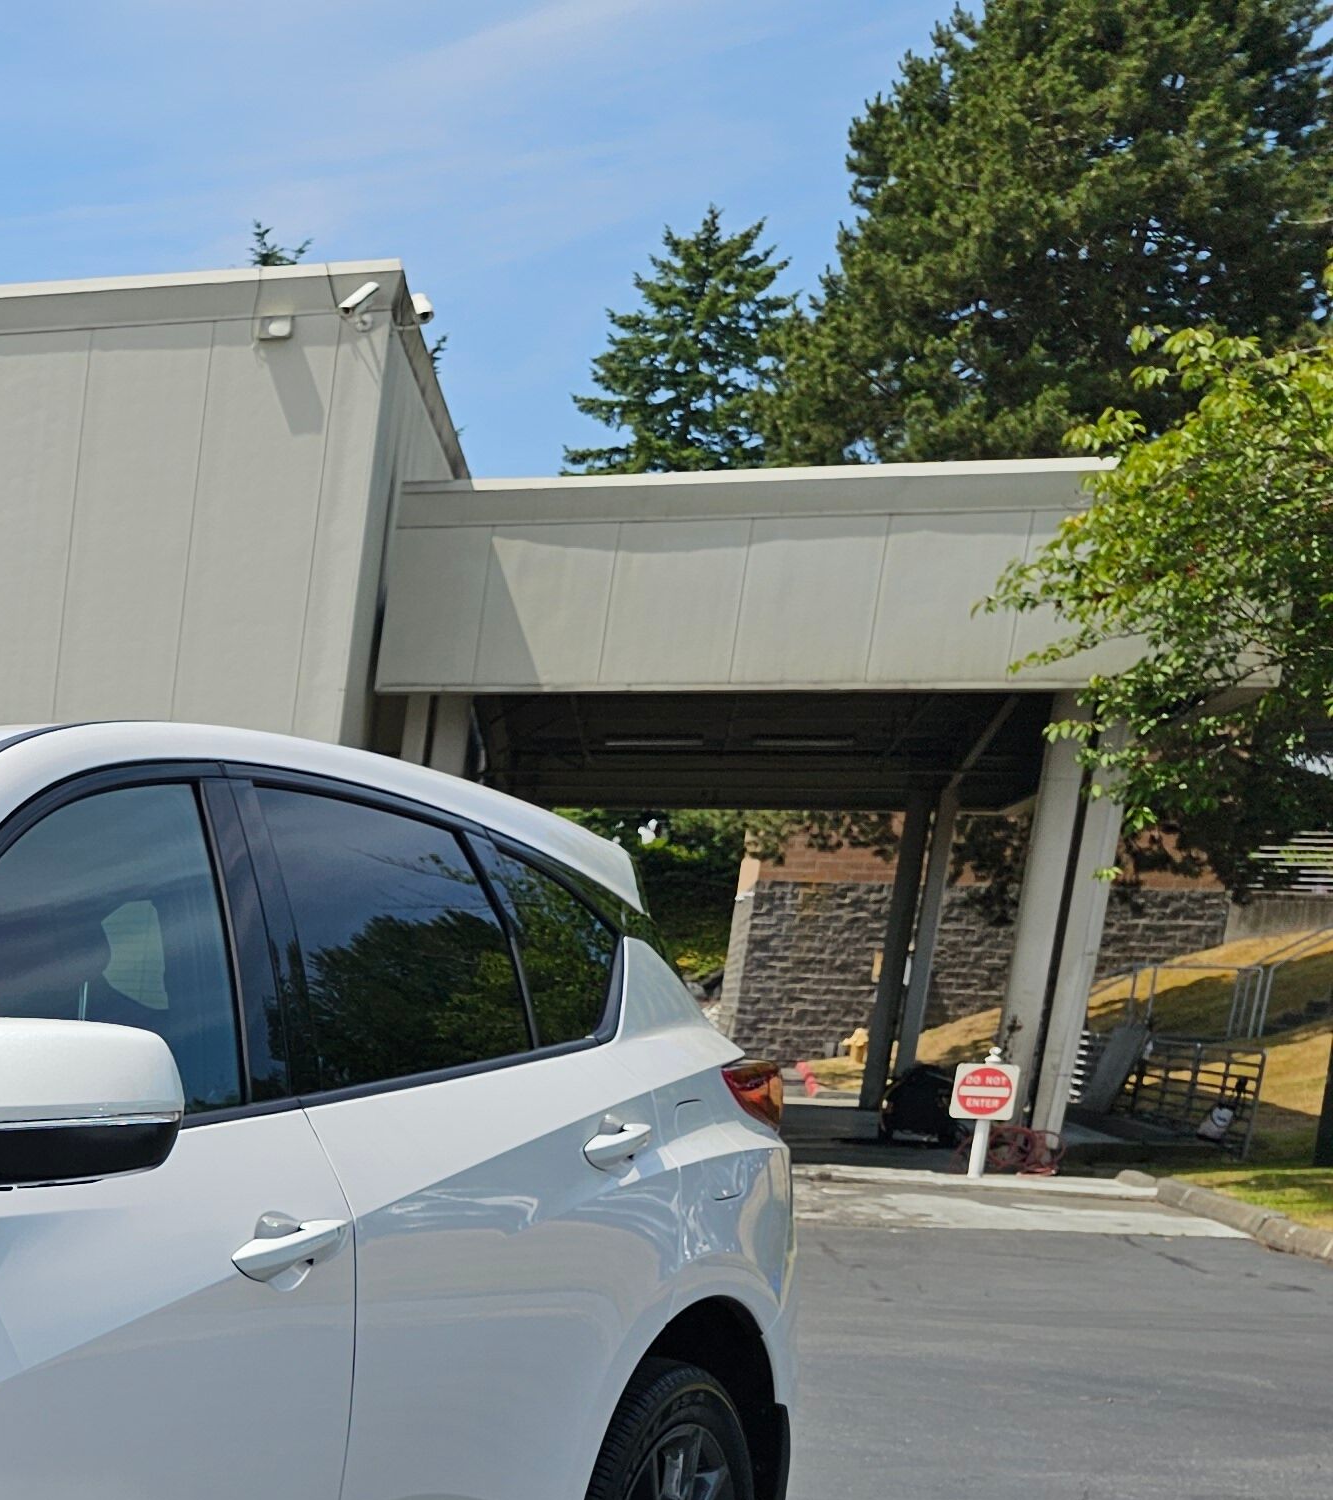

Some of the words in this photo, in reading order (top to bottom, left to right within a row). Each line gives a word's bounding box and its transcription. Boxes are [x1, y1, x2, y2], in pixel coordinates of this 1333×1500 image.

[965, 1075, 982, 1085] DO
[985, 1075, 1009, 1086] NOT
[965, 1097, 1000, 1109] ENTER
